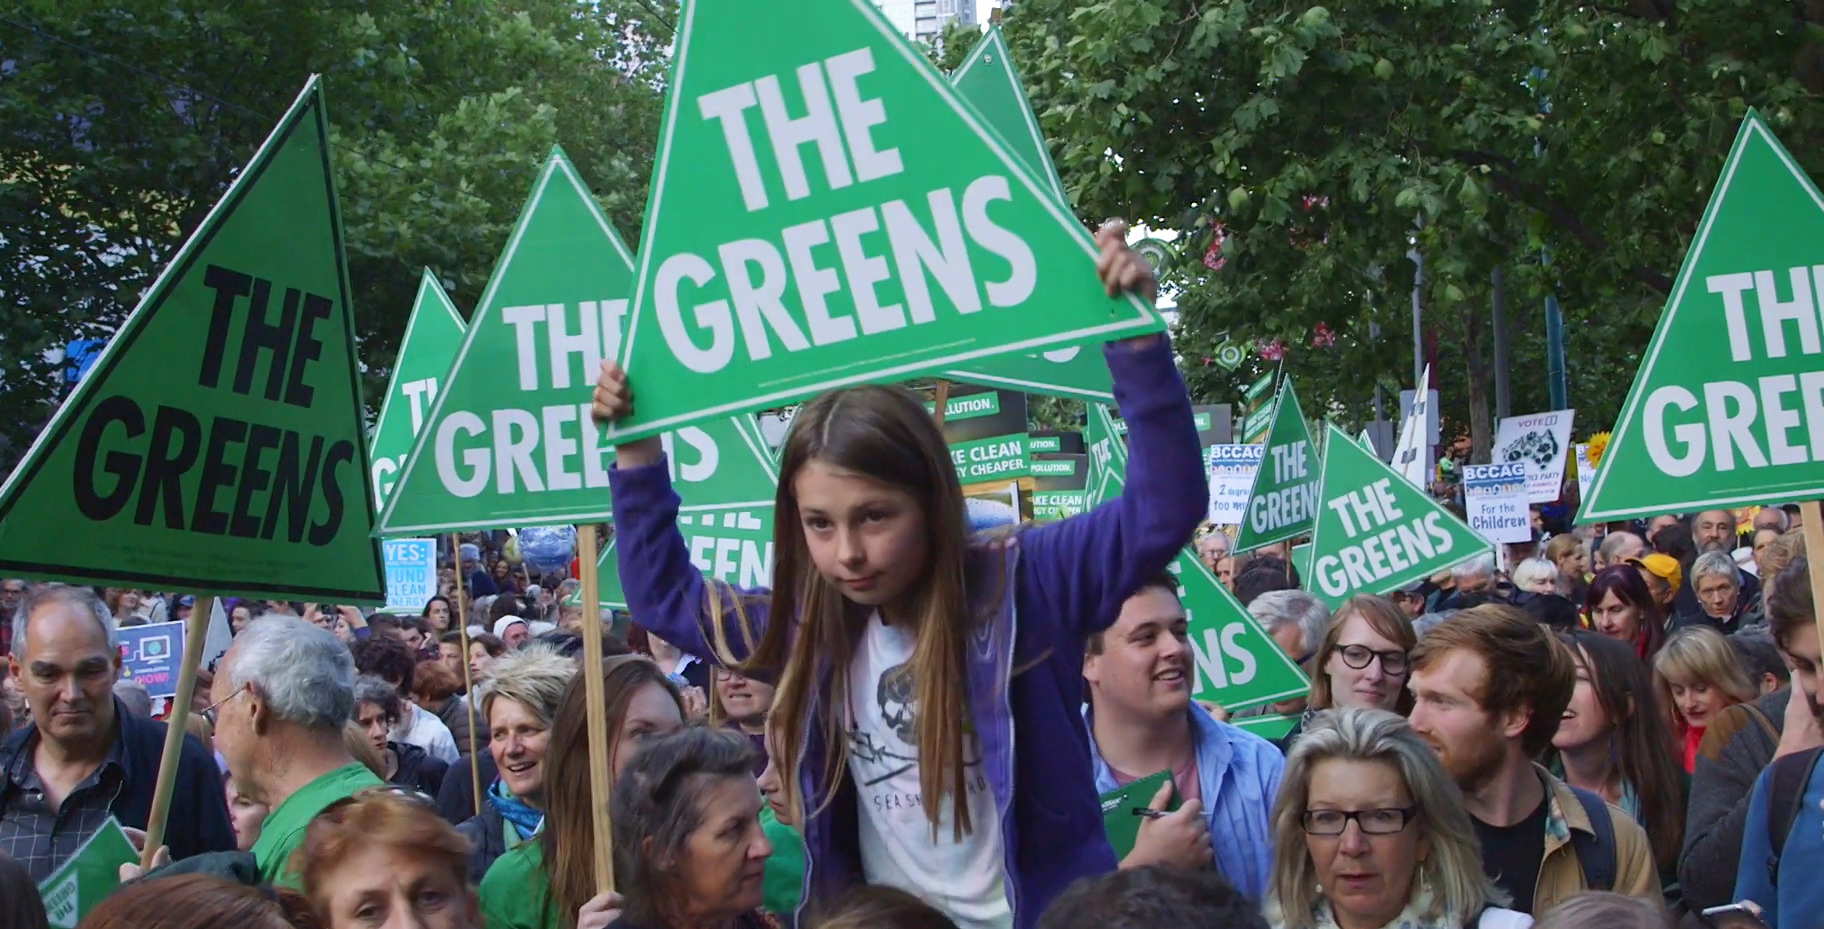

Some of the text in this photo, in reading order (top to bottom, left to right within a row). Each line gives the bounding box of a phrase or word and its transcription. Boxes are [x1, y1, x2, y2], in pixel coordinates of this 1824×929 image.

[698, 47, 904, 212] THE
[654, 175, 1037, 374] GREENS
[198, 263, 333, 409] THE
[970, 441, 1022, 462] CLEAN
[1211, 446, 1263, 459] BCCAG
[73, 395, 354, 547] GREENS
[970, 458, 1028, 476] CHEAPER.
[1271, 441, 1308, 484] THE
[1466, 464, 1525, 480] BCCAG
[1220, 484, 1226, 496] 2
[1050, 495, 1082, 505] CLEAN
[1214, 501, 1230, 511] too
[1328, 478, 1404, 538] THE
[1481, 502, 1515, 515] For the
[1472, 515, 1527, 530] Children
[385, 544, 425, 561] YES:
[1315, 510, 1454, 597] GREENS
[388, 583, 426, 597] CLEAN
[873, 794, 901, 811] SEA
